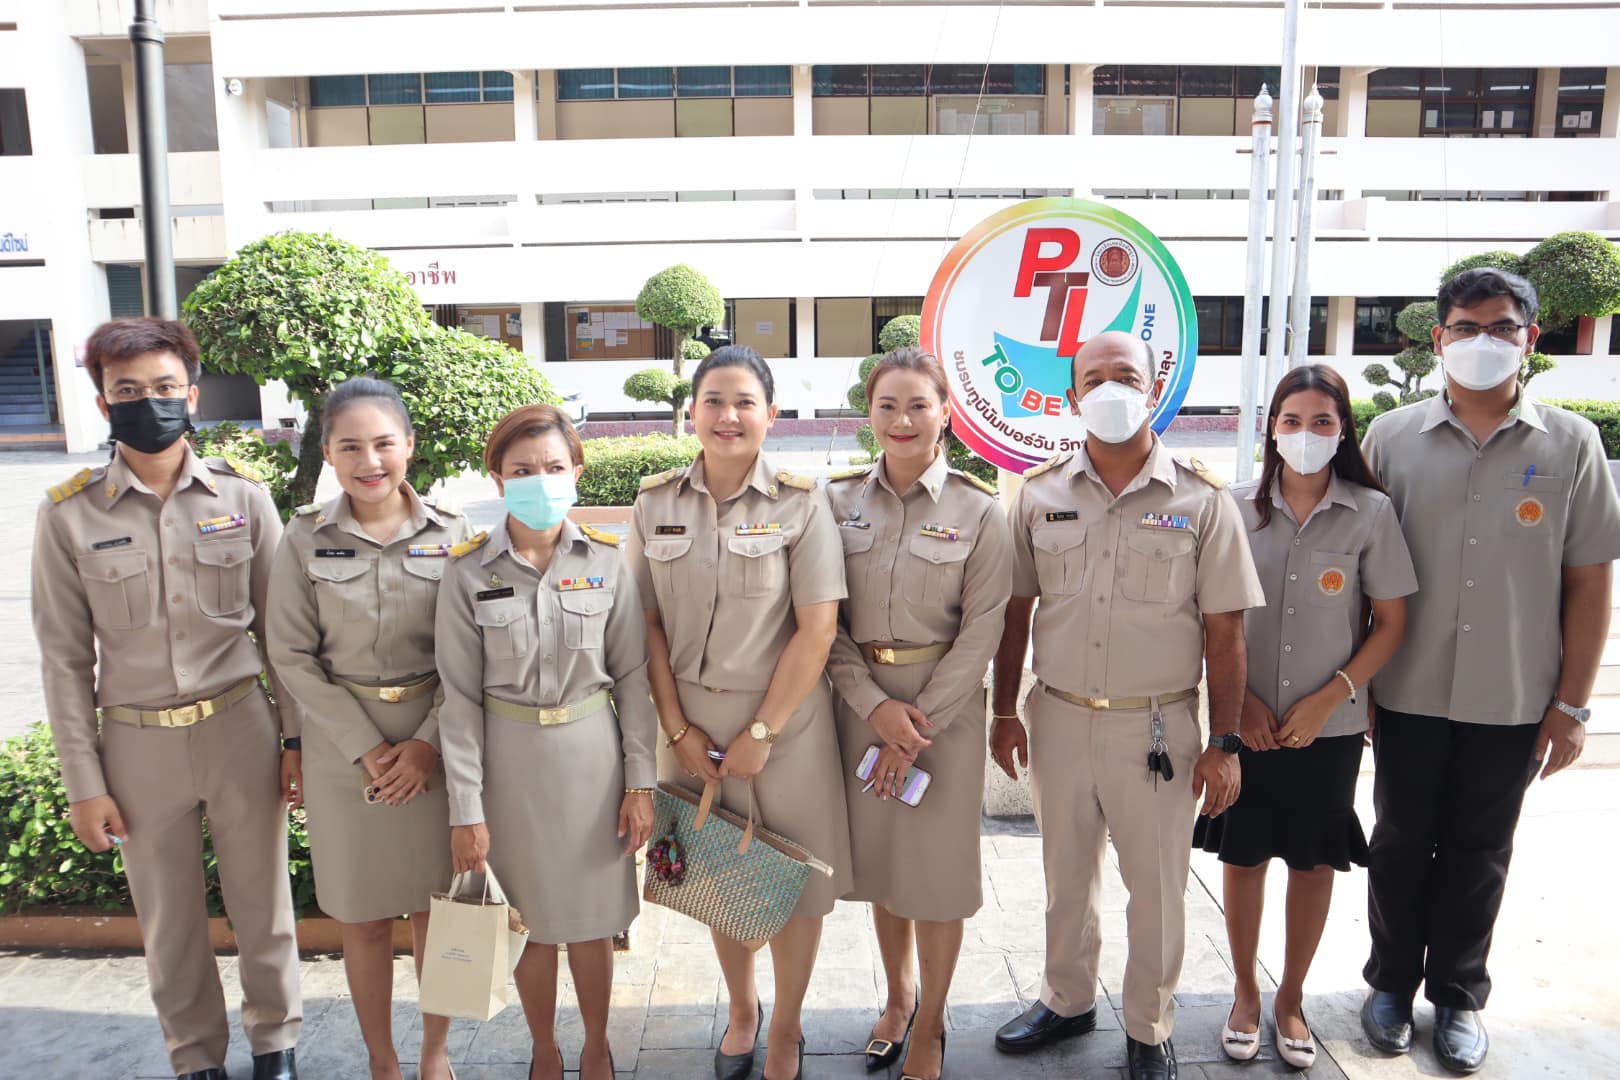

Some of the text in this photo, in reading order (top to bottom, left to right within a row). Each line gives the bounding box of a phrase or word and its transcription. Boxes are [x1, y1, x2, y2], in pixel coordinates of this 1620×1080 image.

[981, 303, 1156, 417] TO BE ONE
